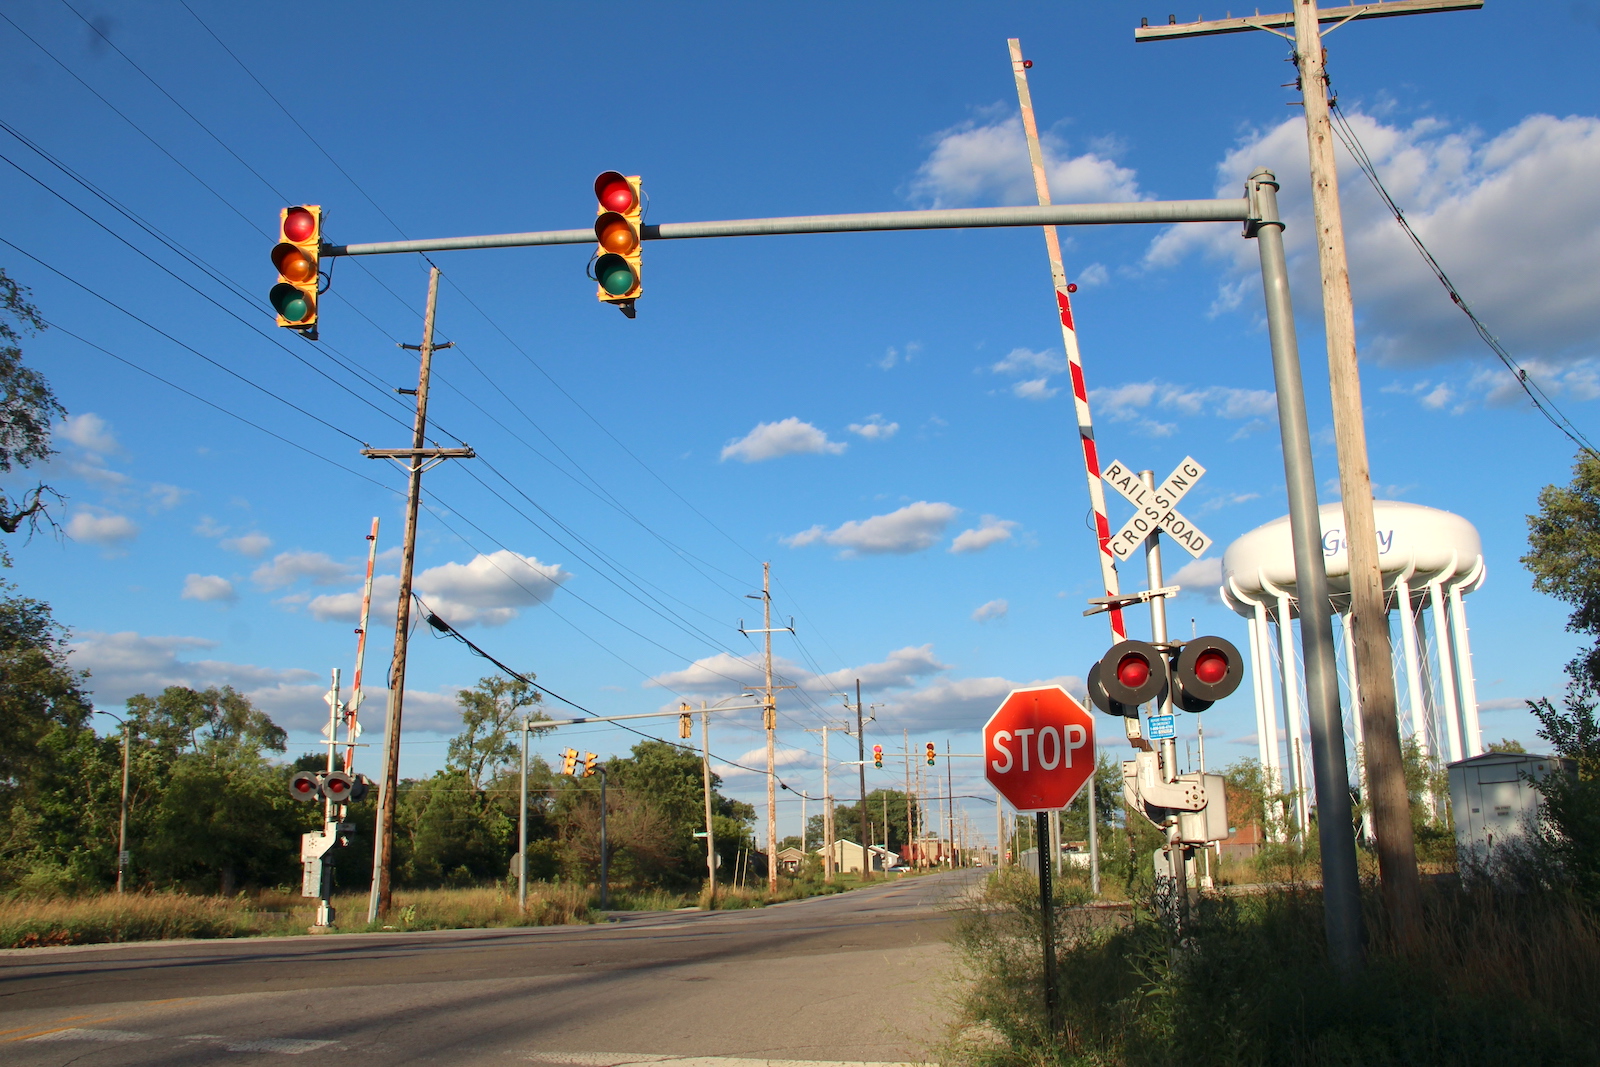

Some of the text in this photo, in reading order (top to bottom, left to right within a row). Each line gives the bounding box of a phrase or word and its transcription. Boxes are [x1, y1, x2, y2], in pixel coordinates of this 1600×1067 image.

[1106, 465, 1204, 551] RAIL ROAD
[1112, 464, 1198, 556] CROSSING
[1321, 529, 1393, 556] Gy
[991, 724, 1087, 774] STOP
